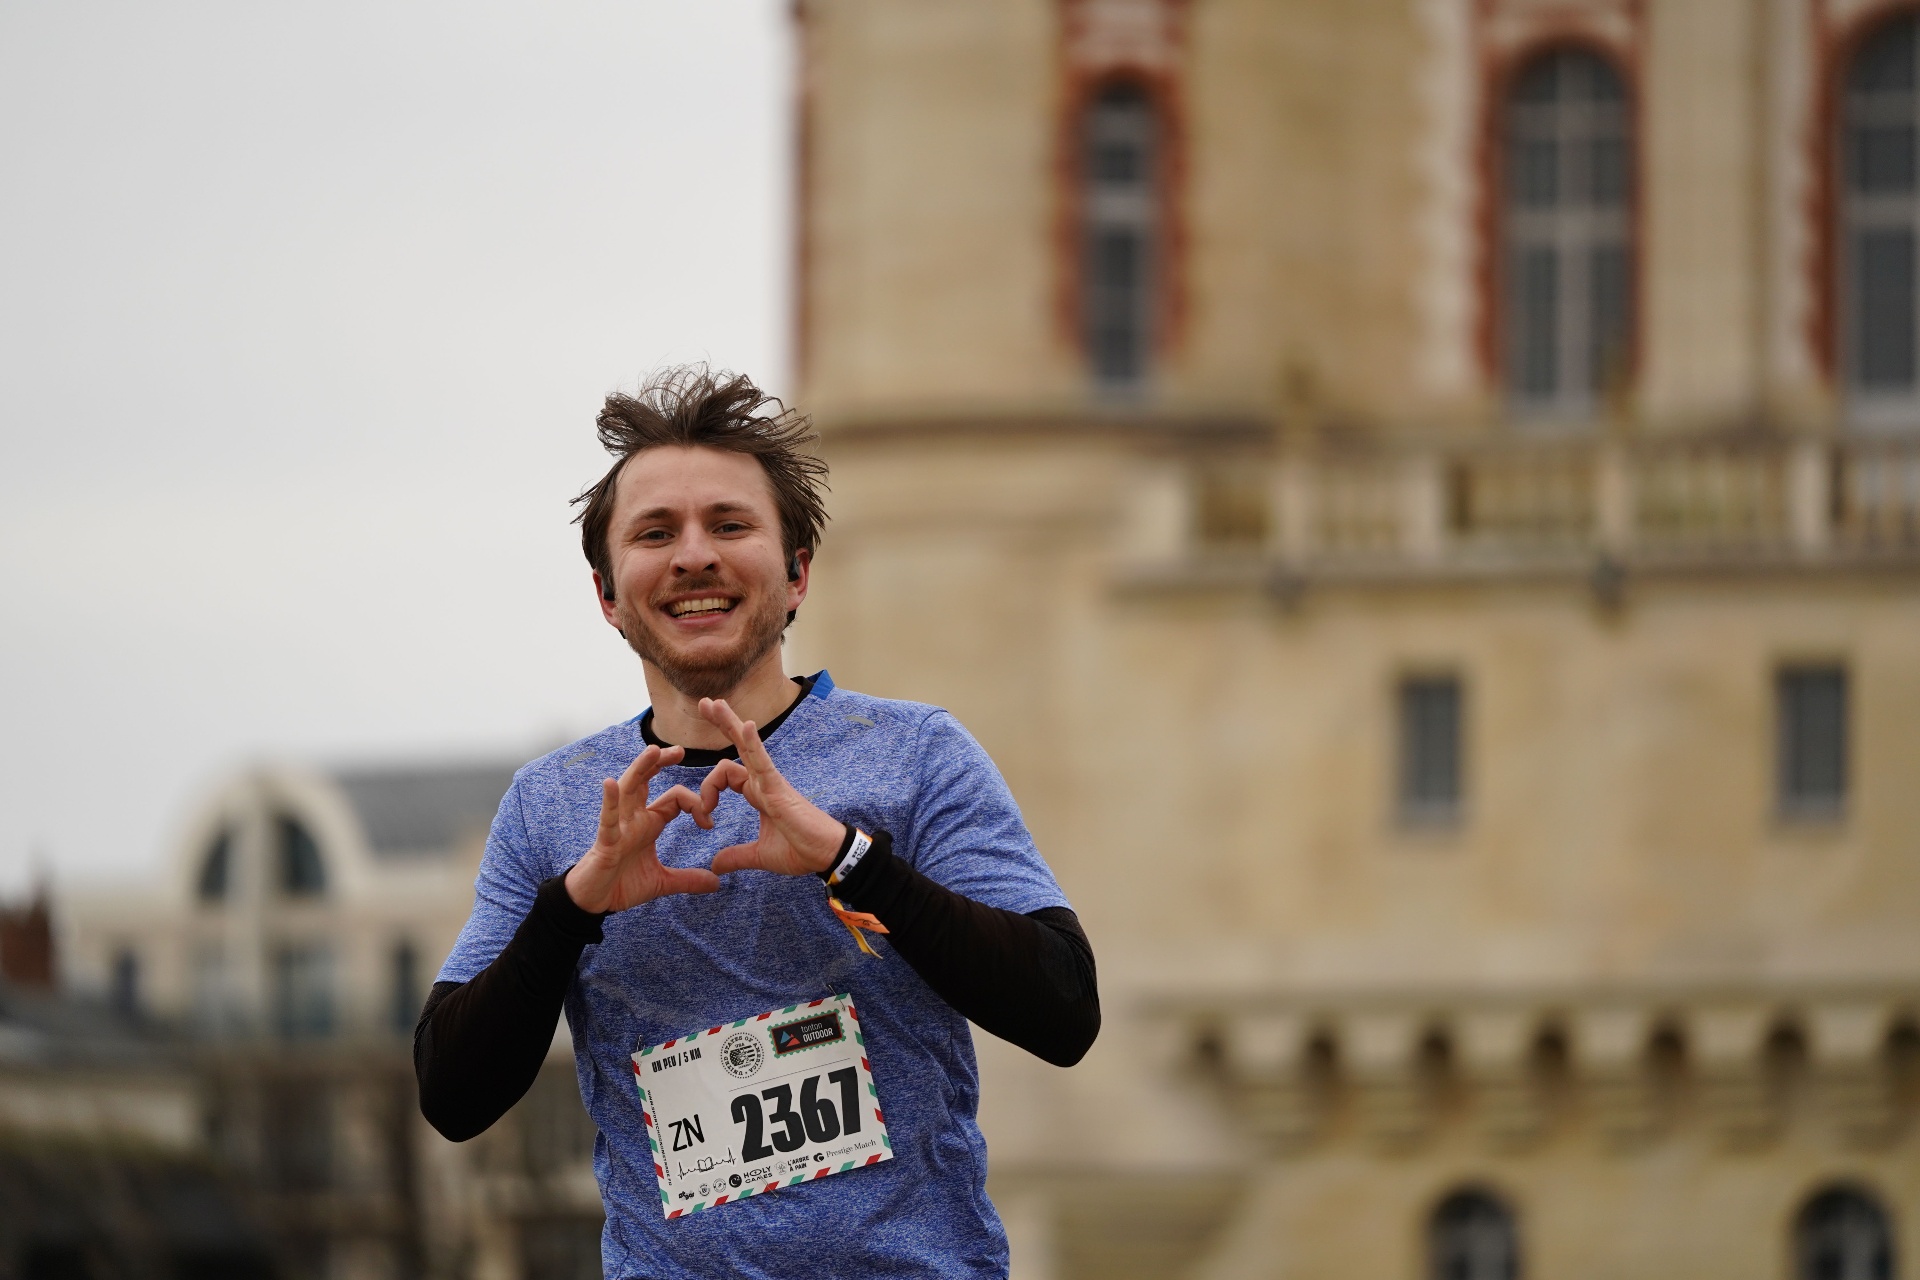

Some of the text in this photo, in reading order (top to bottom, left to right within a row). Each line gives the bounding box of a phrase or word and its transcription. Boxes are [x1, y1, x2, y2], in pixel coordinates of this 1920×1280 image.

[801, 1022, 823, 1033] tonton
[803, 1028, 834, 1042] OUTDOOR
[652, 1047, 702, 1073] UN PEU / 5 KM
[730, 1066, 861, 1163] 2367
[668, 1113, 705, 1152] ZN
[825, 1139, 877, 1158] Prestige Match
[743, 1165, 772, 1178] HOLY
[745, 1172, 773, 1184] GAMES
